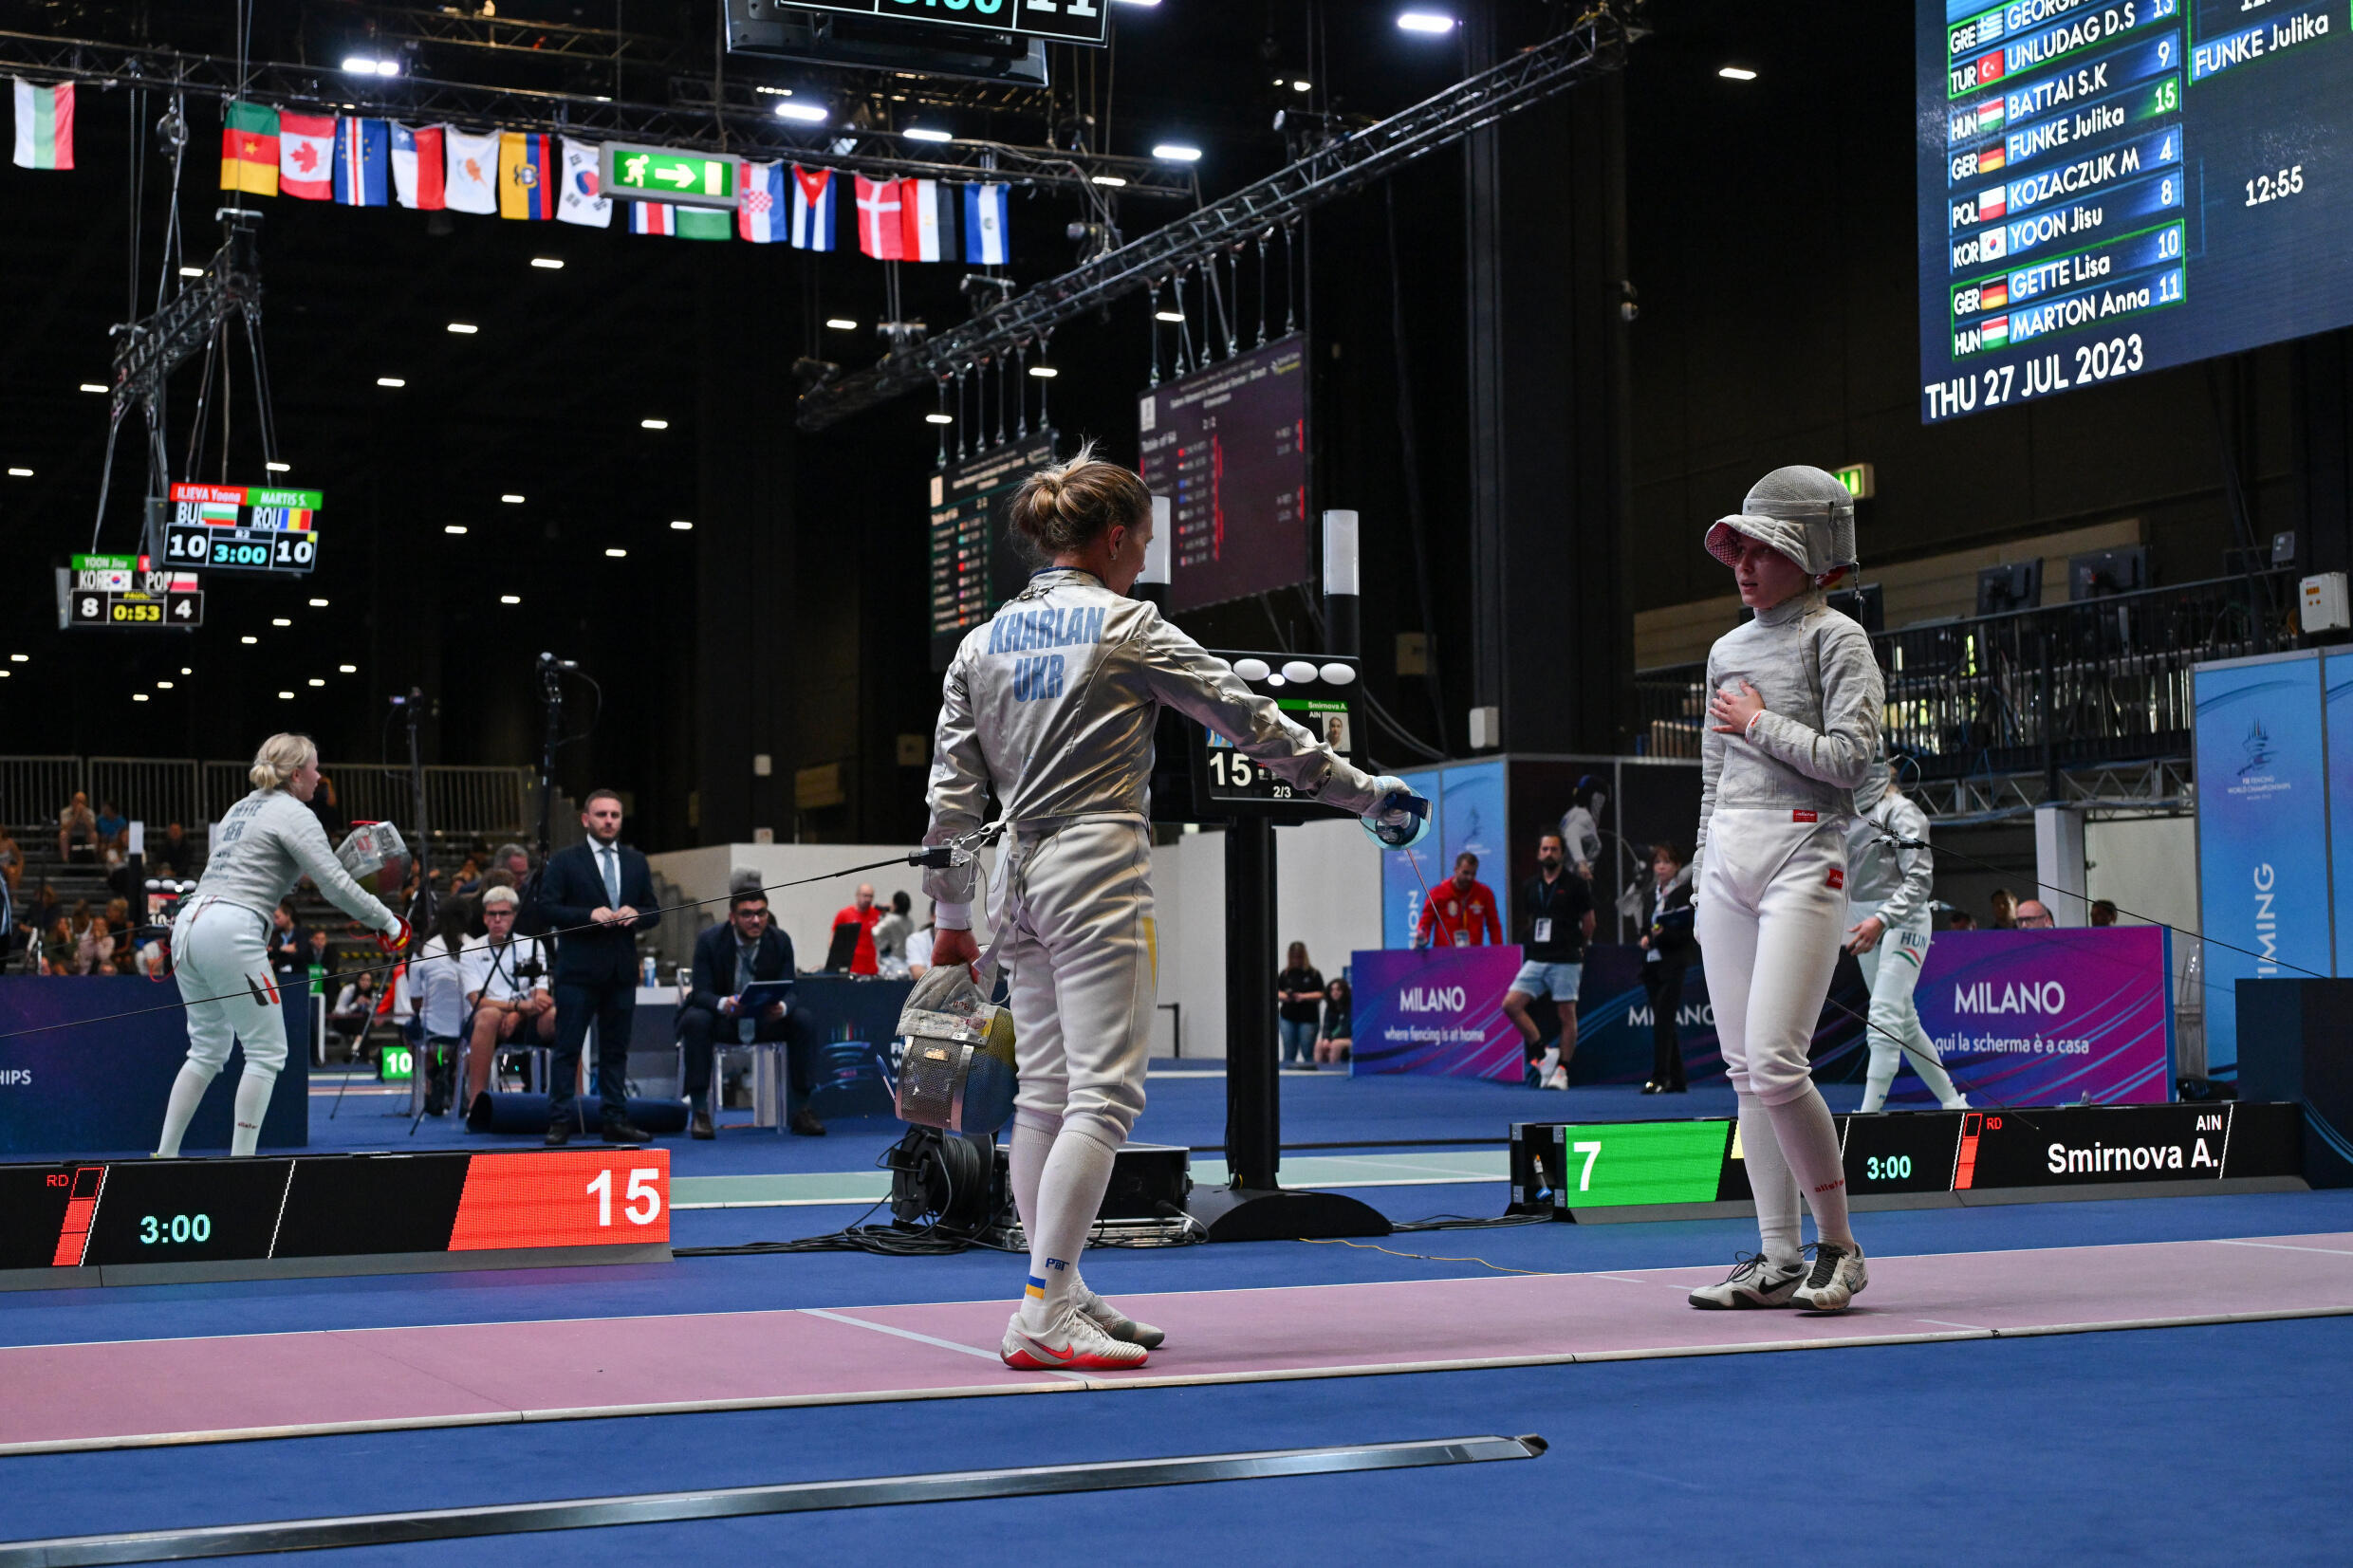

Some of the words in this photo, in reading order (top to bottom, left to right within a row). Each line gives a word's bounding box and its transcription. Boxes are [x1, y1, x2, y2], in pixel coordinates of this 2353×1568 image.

[1950, 26, 1976, 54] GRE
[2009, 16, 2101, 71] UNLUDAG
[2105, 3, 2135, 36] D.S
[2195, 29, 2263, 76] FUNKE
[2269, 13, 2329, 51] Julika
[2158, 41, 2170, 67] 9
[1951, 65, 1977, 93] TUR
[2010, 74, 2074, 120] BATTAI
[2078, 63, 2108, 95] S.K
[2155, 82, 2176, 113] 15
[1952, 113, 1977, 141] HUN
[2010, 119, 2068, 160] FUNKE
[2072, 104, 2125, 140] Julika
[2159, 135, 2173, 161] 4
[1952, 153, 1978, 181] GER
[2010, 153, 2116, 210] KOZACZUK
[2121, 147, 2140, 175] M
[2161, 179, 2173, 205] 8
[2245, 165, 2304, 207] 12:55
[1953, 201, 1979, 229] POL
[2010, 211, 2066, 249] YOON
[2070, 206, 2103, 233] Jisu
[1953, 240, 1980, 268] KOR
[2158, 229, 2178, 259] 10
[2011, 259, 2070, 299] GETTE
[2075, 254, 2111, 282] Lisa
[2159, 273, 2180, 303] 11
[1954, 288, 1981, 315] GER
[2012, 295, 2095, 341] MARTON
[2100, 286, 2150, 317] Anna
[1955, 328, 1981, 356] HUN
[1925, 374, 1977, 419] THU
[1984, 365, 2015, 406] 27
[2021, 354, 2069, 397] JUL
[2075, 333, 2143, 385] 2023
[252, 507, 282, 528] ROU
[170, 535, 207, 557] 10
[213, 544, 267, 564] 3:00
[277, 541, 313, 563] 10
[82, 597, 99, 618] 8
[113, 604, 160, 621] 0:53
[175, 599, 192, 618] 4
[988, 607, 1106, 655] KHARLAN
[1014, 654, 1065, 702] UKR
[1308, 701, 1339, 710] Smirnova
[1340, 702, 1347, 710] A.
[1309, 711, 1322, 719] AIN
[1209, 751, 1252, 787] 15
[1273, 786, 1292, 798] 2/3
[2253, 863, 2277, 979] IMING
[1900, 931, 1929, 948] HUN
[1400, 986, 1466, 1012] MILANO
[1955, 981, 2065, 1015] MILANO
[1628, 1004, 1716, 1026] MIANO
[1384, 1025, 1409, 1041] where
[1409, 1025, 1441, 1046] fencing
[1459, 1026, 1485, 1042] home
[1935, 1034, 1955, 1055] qui
[1958, 1032, 1971, 1052] la
[1973, 1033, 2031, 1053] scherma
[2034, 1035, 2041, 1054] è
[2046, 1041, 2054, 1054] a
[2057, 1040, 2090, 1055] casa
[387, 1052, 413, 1073] 10
[1986, 1117, 2002, 1130] RD
[2196, 1115, 2222, 1132] AIN
[1574, 1141, 1602, 1191] 7
[1867, 1155, 1911, 1180] 3:00
[2047, 1142, 2183, 1174] Smirnova
[2191, 1138, 2219, 1168] A.
[47, 1175, 69, 1188] RD
[586, 1168, 661, 1227] 15
[140, 1214, 211, 1244] 3:00
[1045, 1257, 1070, 1272] PBT
